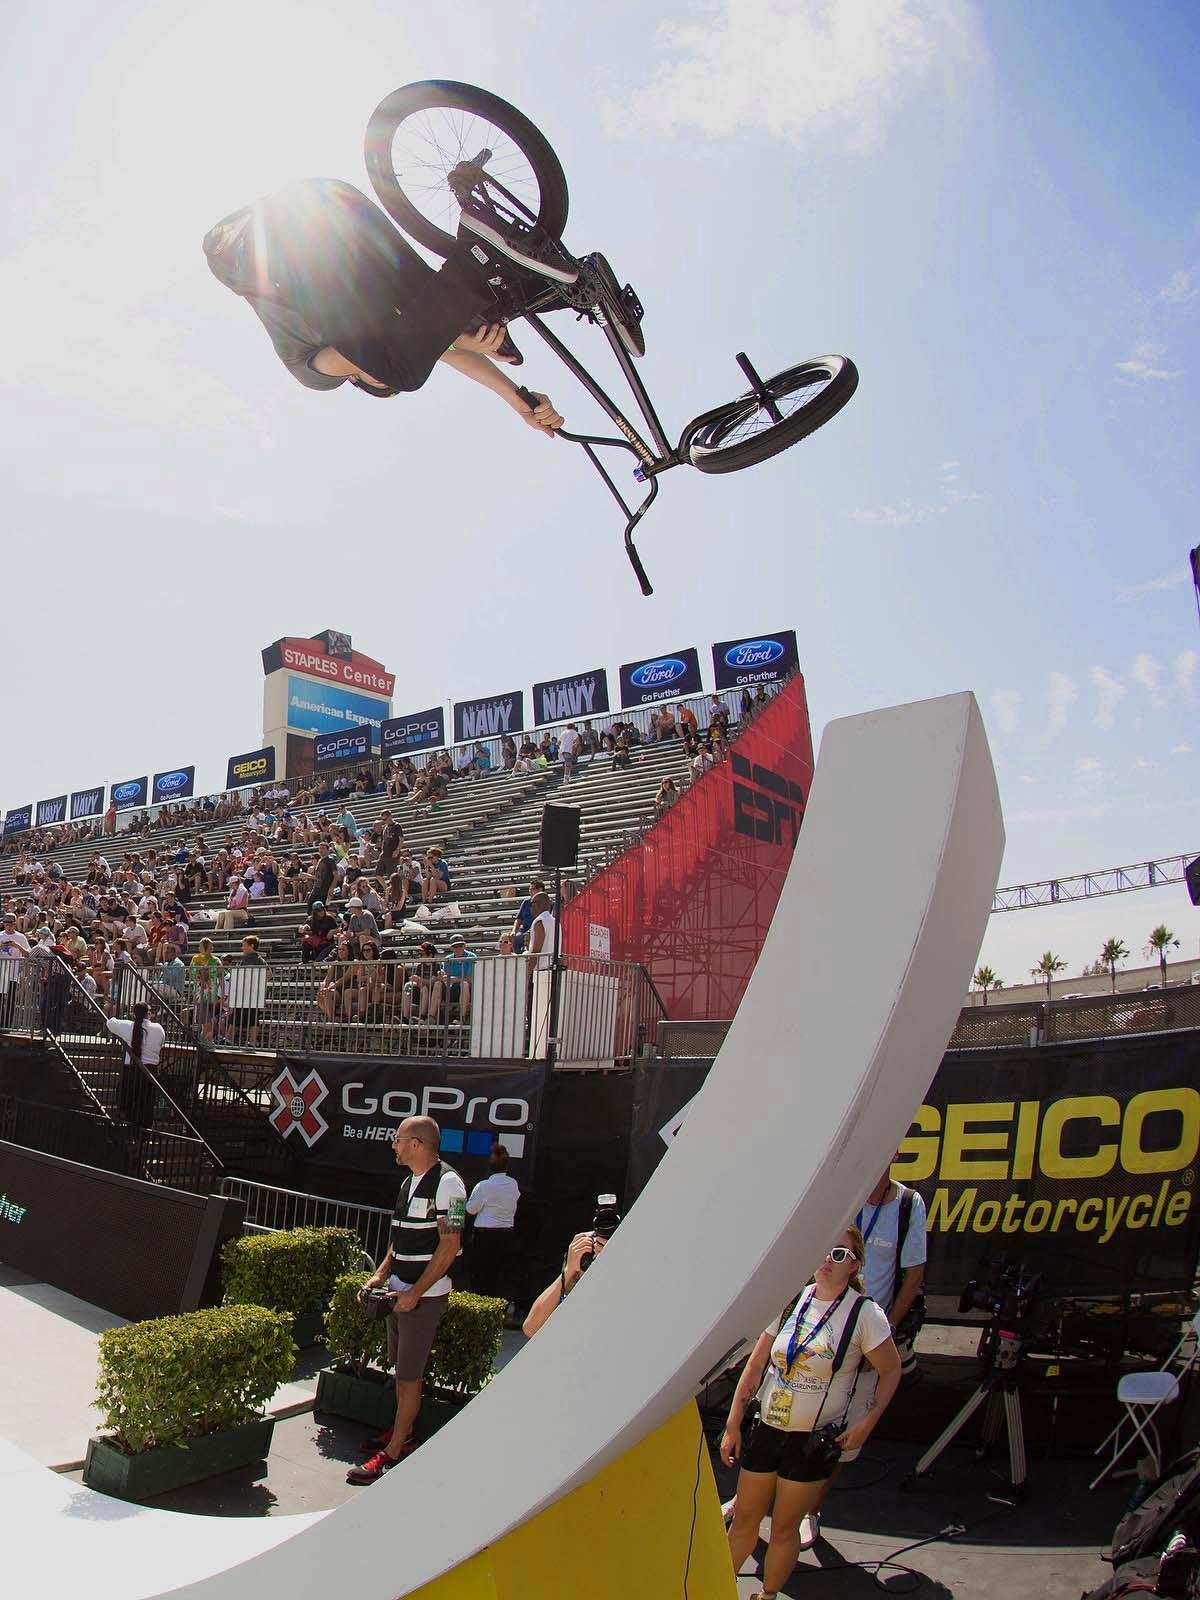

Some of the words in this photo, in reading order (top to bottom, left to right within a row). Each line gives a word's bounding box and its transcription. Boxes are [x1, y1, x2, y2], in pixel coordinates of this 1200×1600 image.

[736, 644, 773, 665] Ford
[284, 648, 338, 677] STAPLES
[343, 665, 393, 691] Center
[641, 663, 675, 685] Ford
[736, 674, 748, 685] Go
[749, 671, 778, 683] Further
[542, 684, 596, 721] NAVY
[641, 692, 652, 703] Go
[653, 687, 681, 700] Further
[290, 695, 344, 718] American
[346, 711, 383, 728] Expres
[462, 705, 513, 739] NAVY
[384, 720, 439, 740] GoPro
[316, 736, 367, 754] GoPro
[233, 757, 267, 775] GEICO
[342, 1082, 529, 1127] GoPro
[343, 1124, 356, 1139] Be
[356, 1129, 363, 1139] a
[364, 1126, 397, 1142] HER
[888, 1087, 1200, 1182] GEICO
[926, 1178, 1192, 1244] Motorcycle
